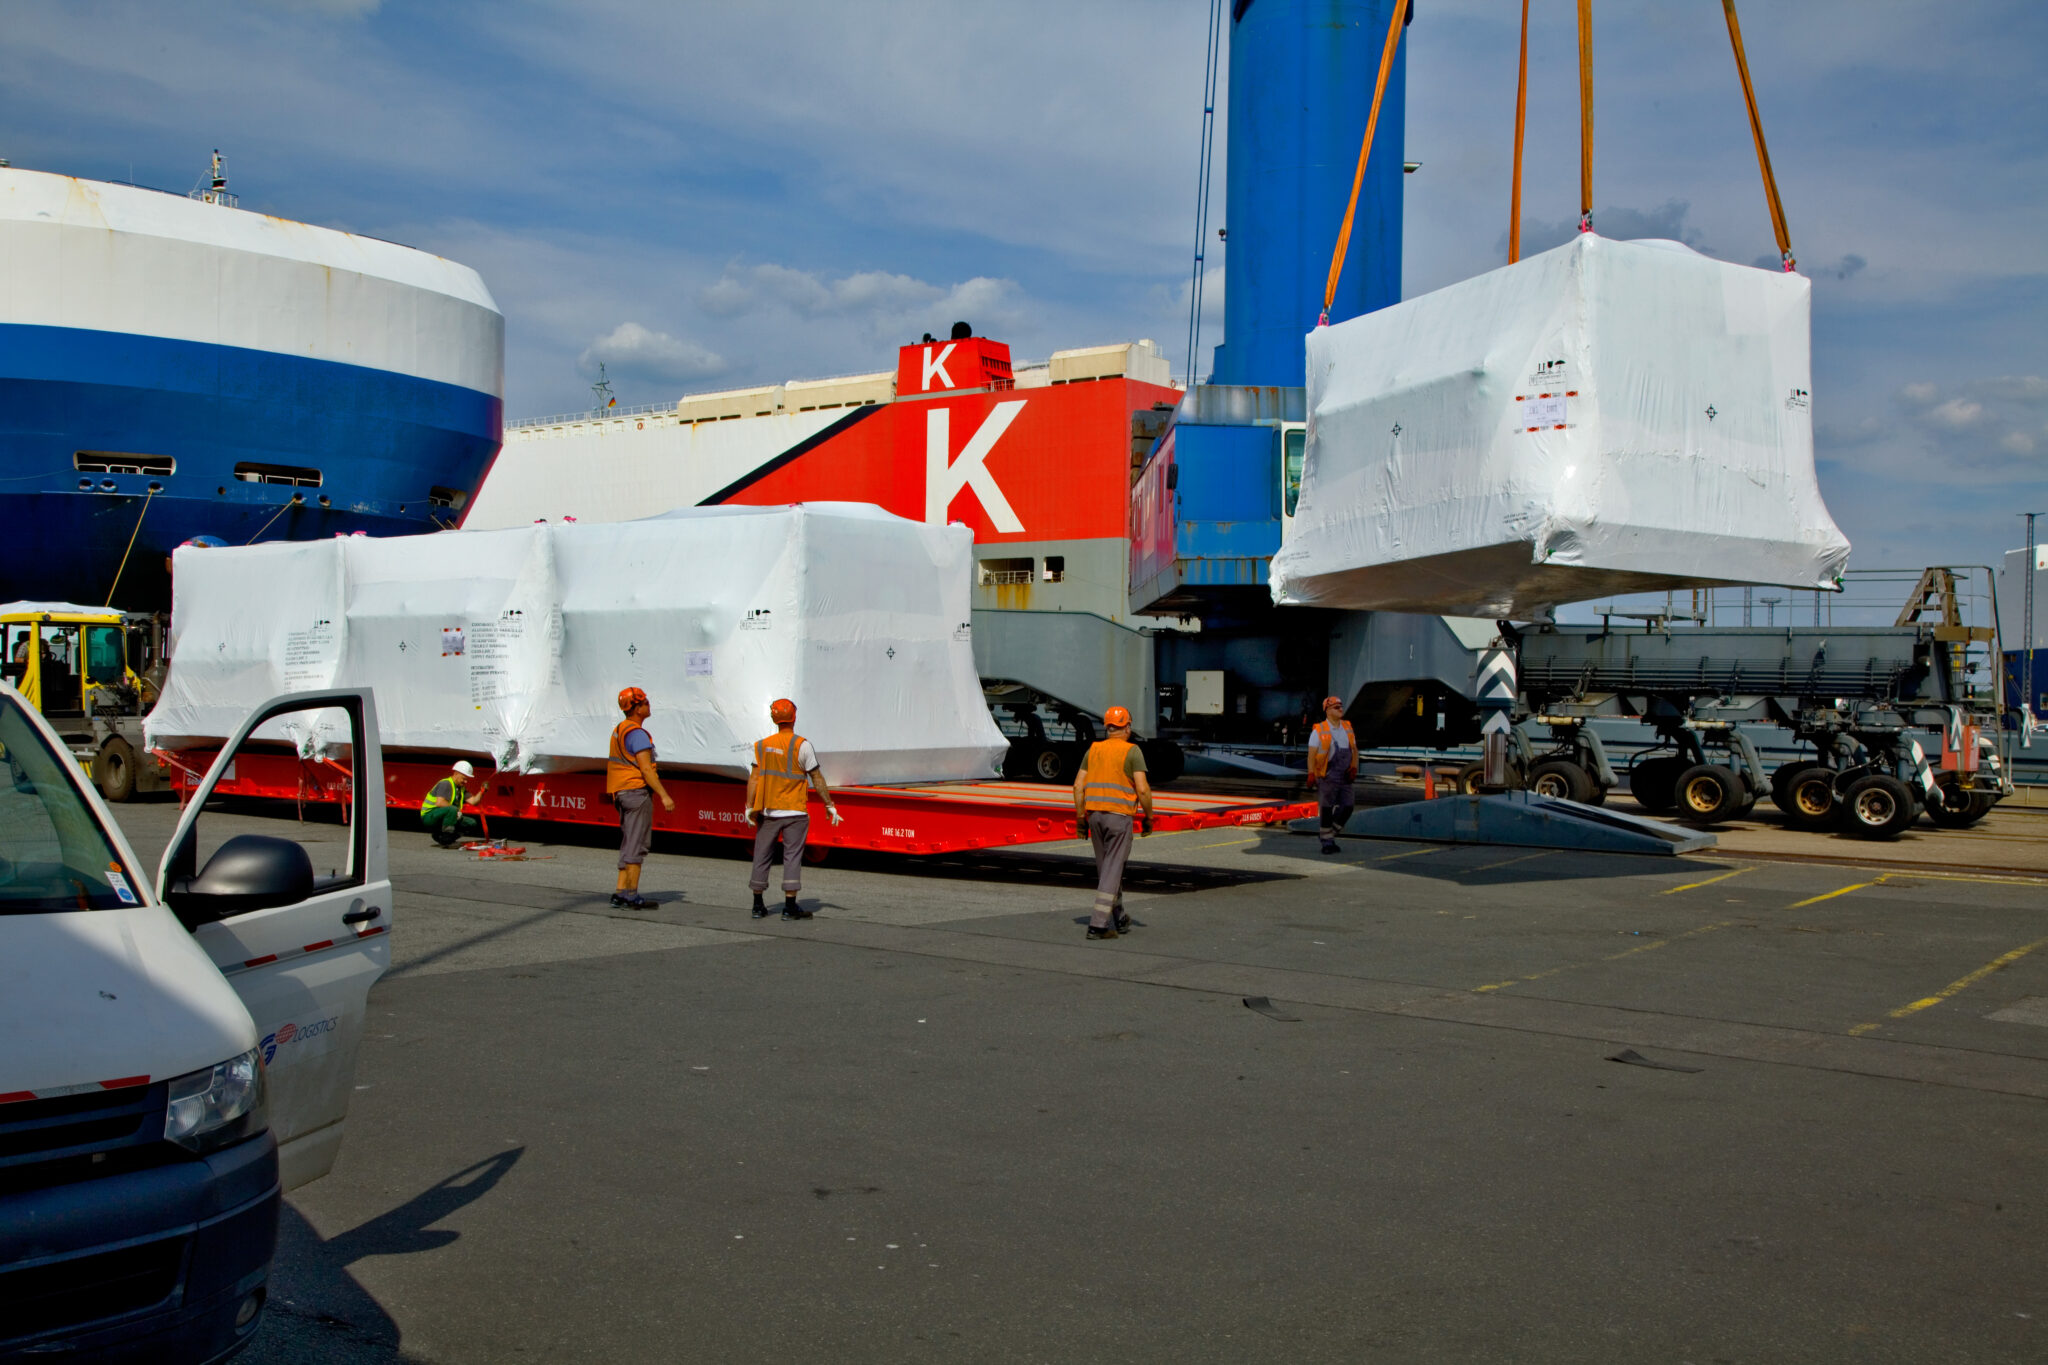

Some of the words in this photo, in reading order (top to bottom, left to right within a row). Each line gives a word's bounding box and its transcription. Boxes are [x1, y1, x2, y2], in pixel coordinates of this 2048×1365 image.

[922, 343, 957, 391] K
[925, 399, 1029, 533] K
[550, 795, 586, 810] LINE
[698, 809, 717, 821] SWL
[718, 811, 732, 823] 120
[882, 826, 894, 837] TARE
[905, 828, 915, 838] TON
[292, 1016, 338, 1043] LOGISTICS
